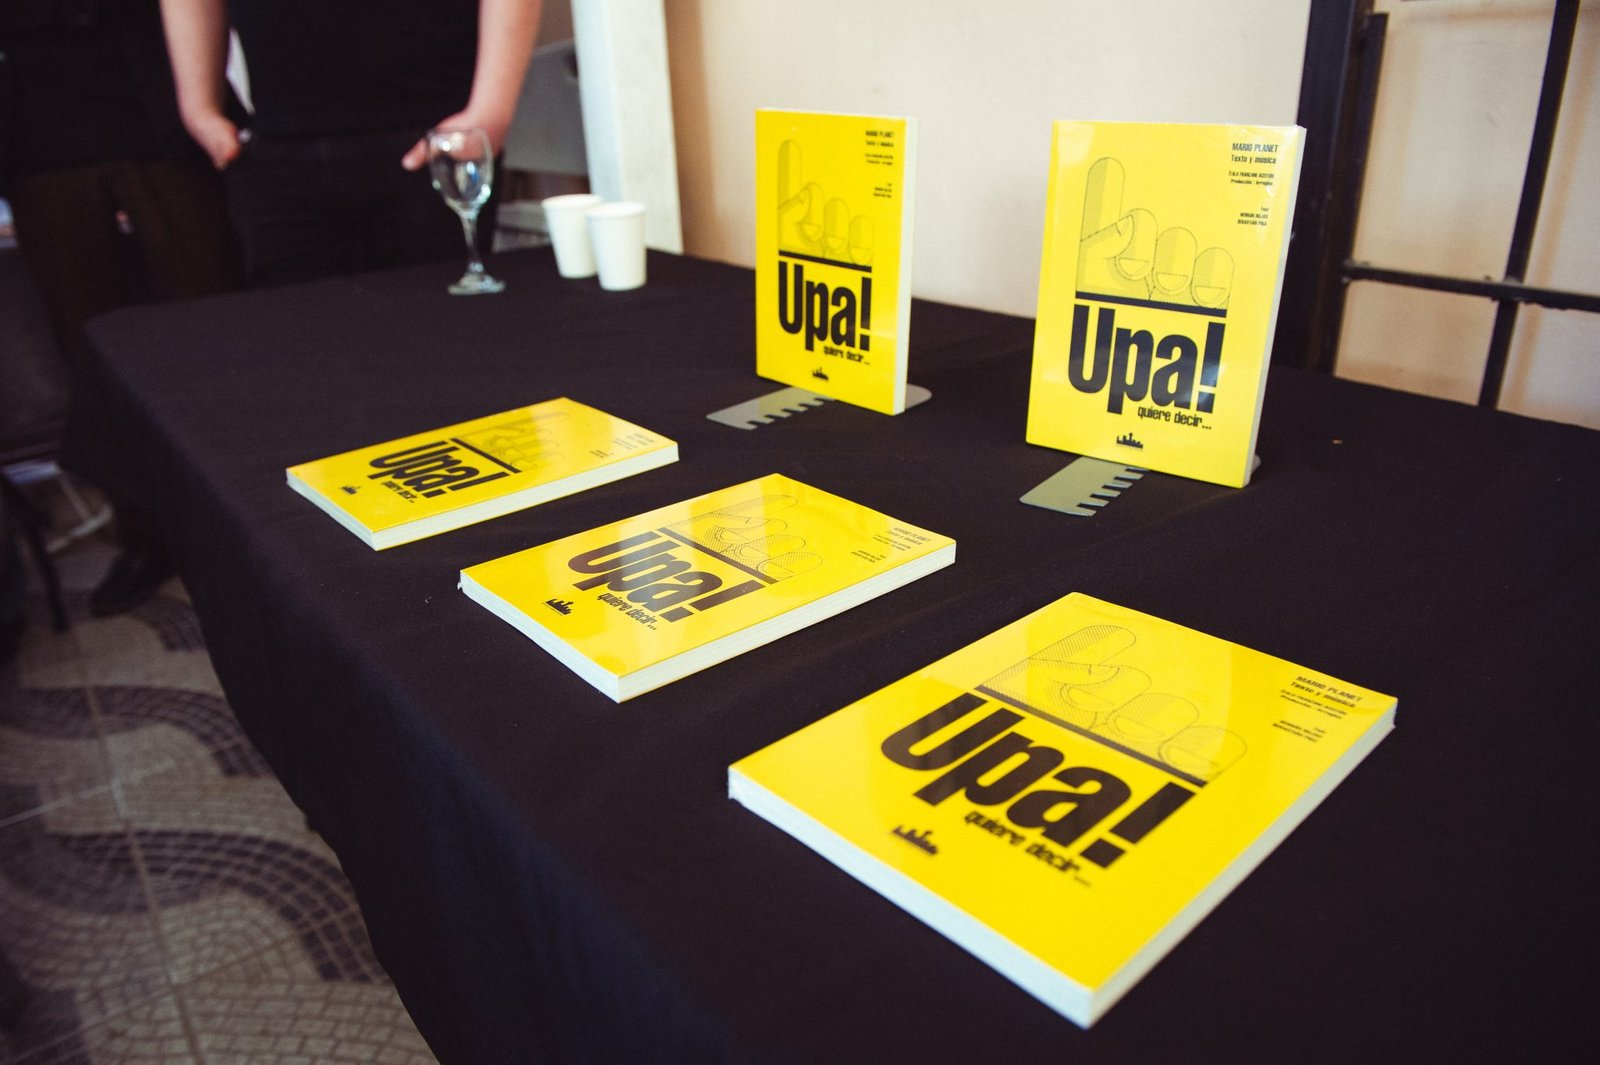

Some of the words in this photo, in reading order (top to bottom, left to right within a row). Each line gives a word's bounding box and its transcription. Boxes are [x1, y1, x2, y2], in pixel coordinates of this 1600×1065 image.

[1231, 143, 1253, 152] MARIO
[1254, 144, 1279, 153] PLANET
[1231, 154, 1248, 163] Texto
[778, 260, 872, 352] Upa!
[1068, 303, 1226, 415] Upa!
[1137, 405, 1171, 422] quiere
[367, 440, 511, 498] Upa!
[567, 530, 766, 623] Upa!
[597, 592, 632, 612] quiere
[881, 692, 1197, 869] Upa!
[963, 810, 1027, 847] quiere
